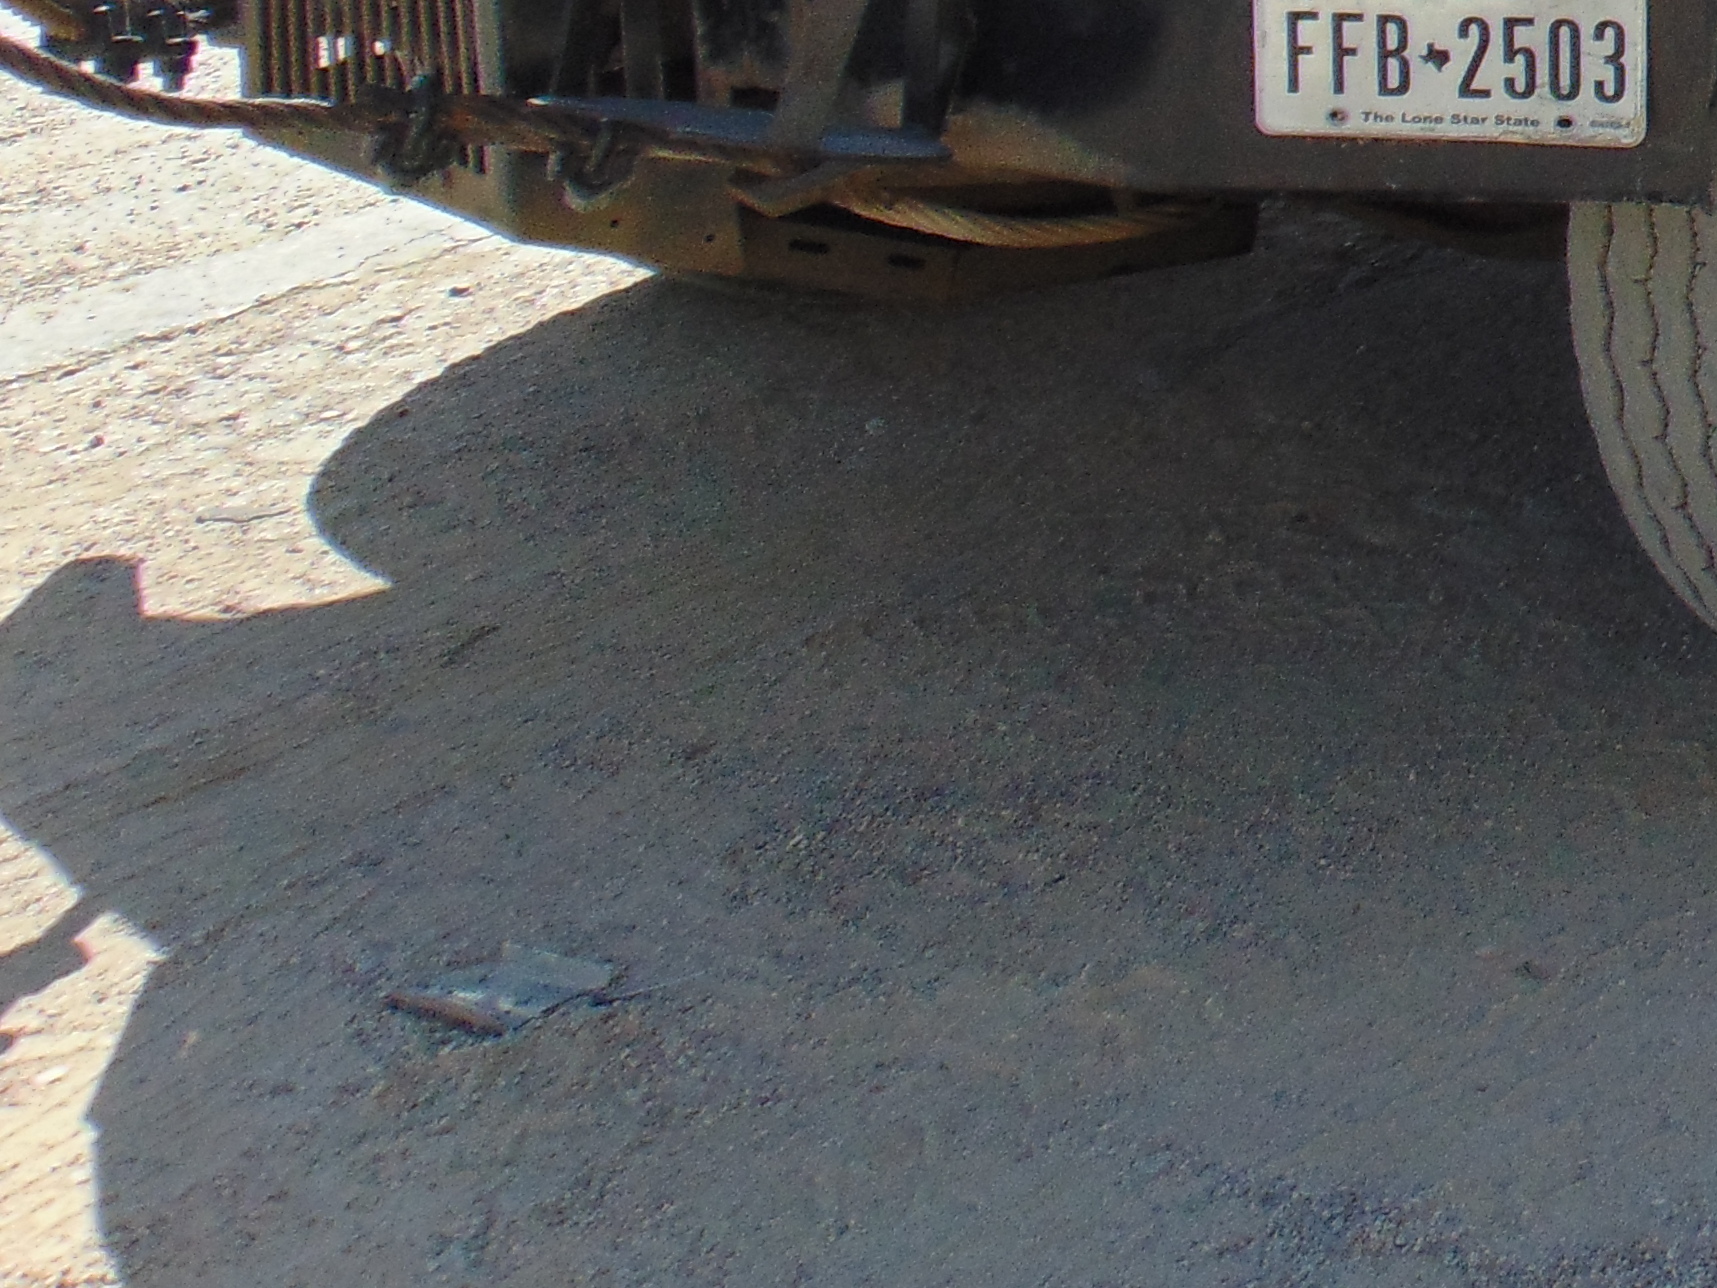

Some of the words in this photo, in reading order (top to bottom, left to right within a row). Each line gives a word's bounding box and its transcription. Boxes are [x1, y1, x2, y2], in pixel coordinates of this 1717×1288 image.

[1361, 110, 1395, 123] The
[1400, 112, 1445, 125] Lone
[1450, 113, 1488, 126] Star
[1494, 115, 1541, 128] State
